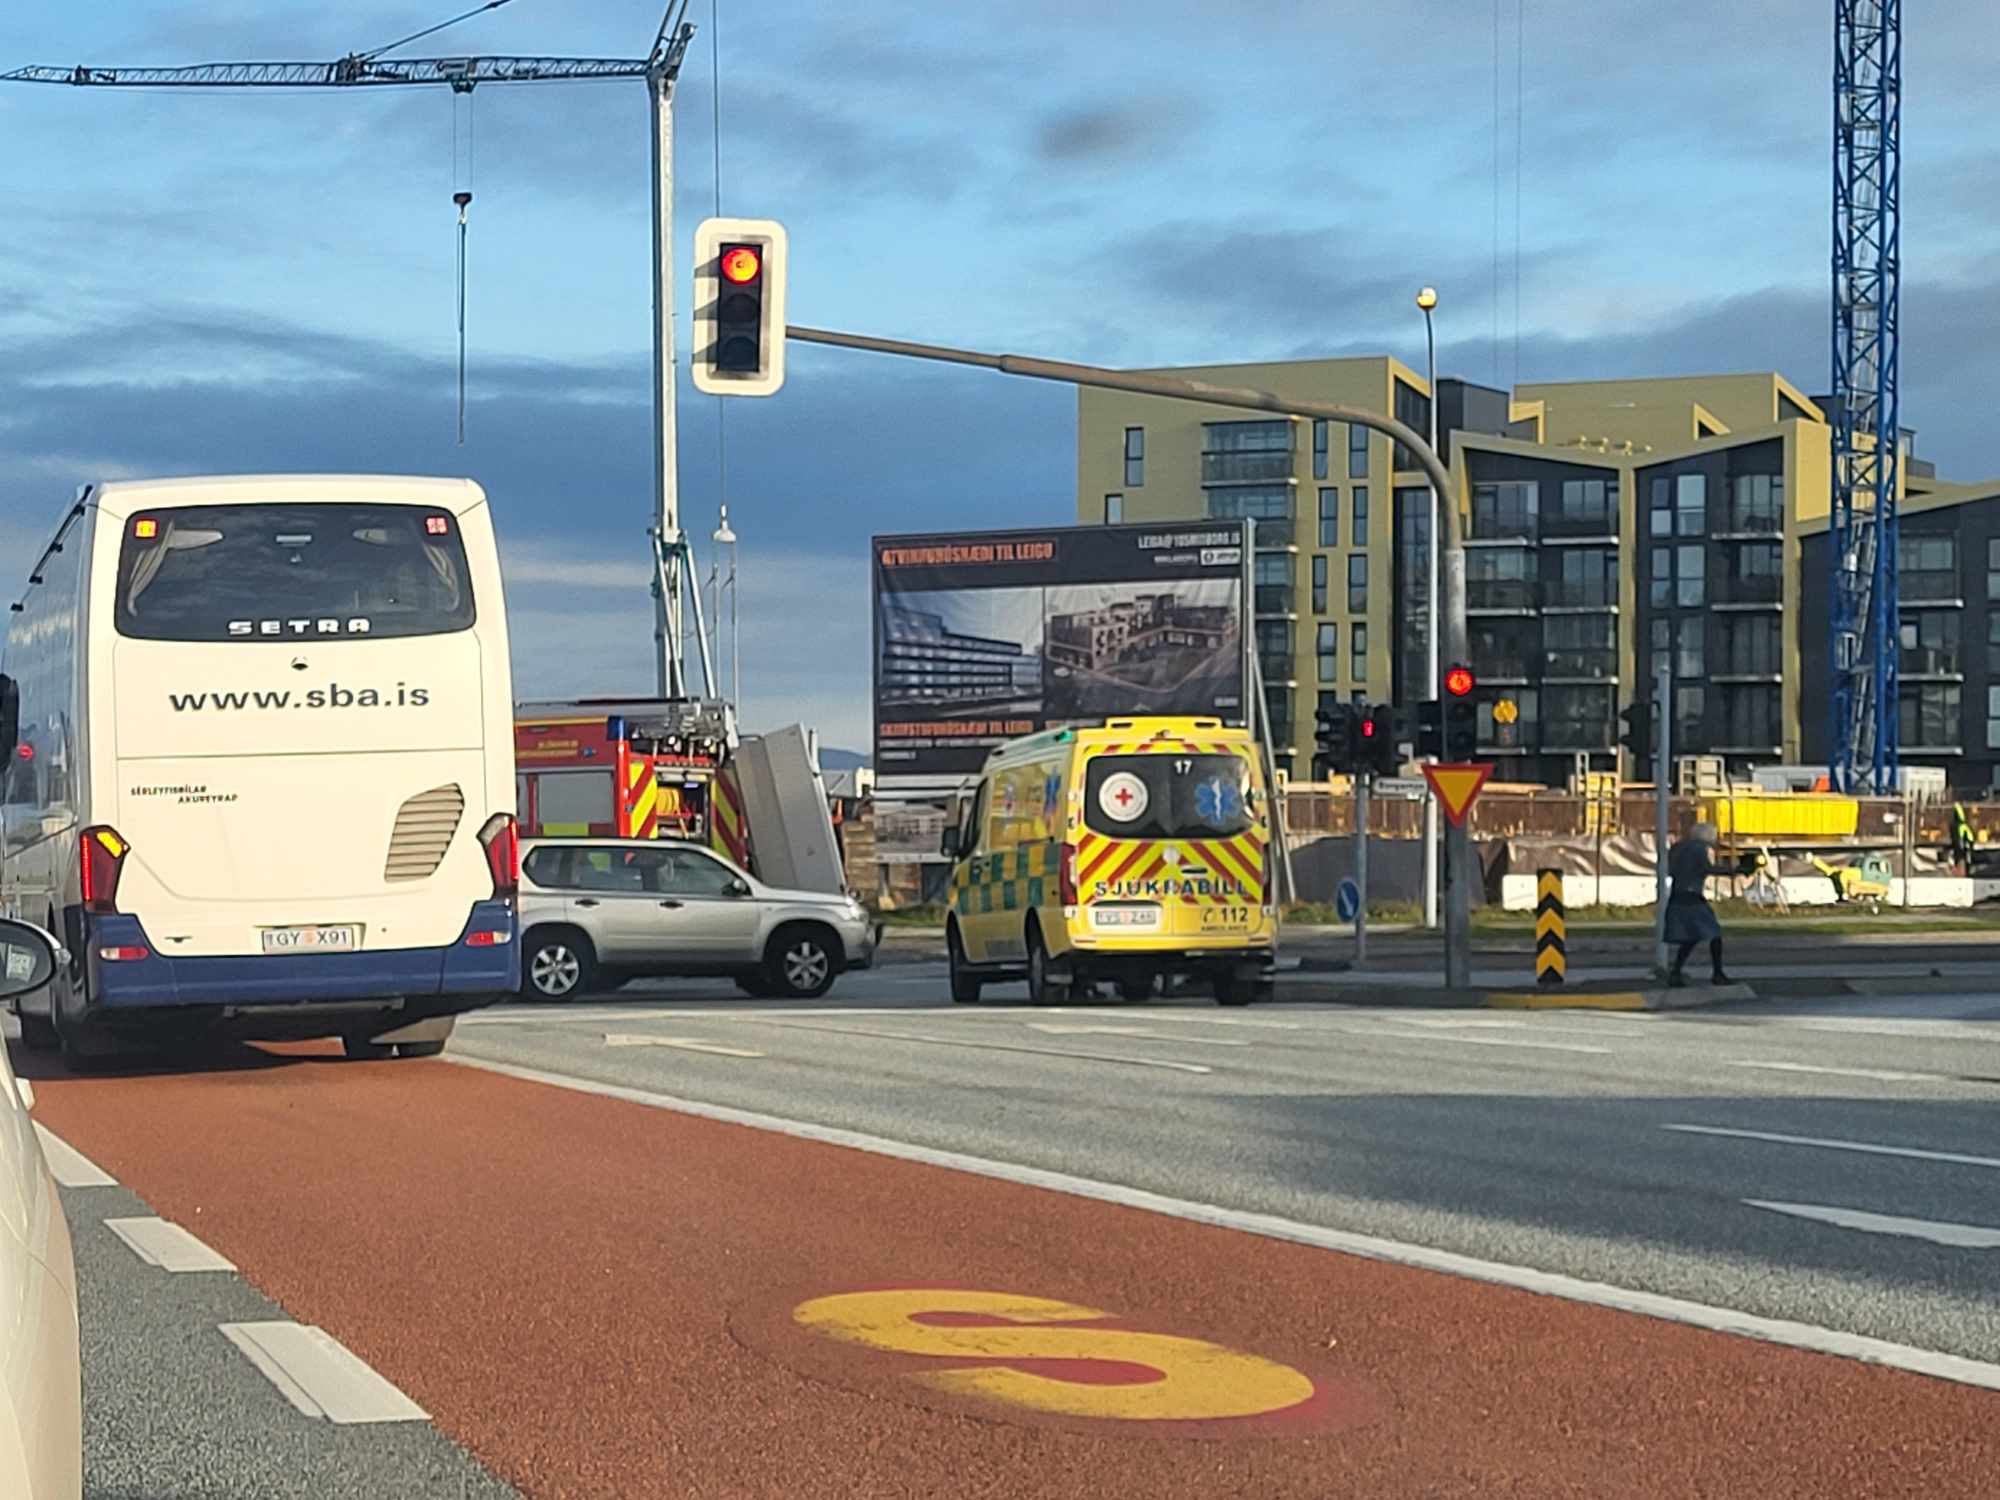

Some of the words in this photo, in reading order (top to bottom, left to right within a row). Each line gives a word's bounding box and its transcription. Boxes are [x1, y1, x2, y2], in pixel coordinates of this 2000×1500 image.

[996, 543, 1014, 560] TIL
[228, 618, 371, 635] SETRA
[169, 682, 429, 711] www.sba.is
[1174, 759, 1193, 775] 17
[1094, 875, 1247, 896] SJÚKRABÍLL
[1220, 906, 1249, 923] 112
[317, 930, 347, 945] X91
[792, 1289, 1315, 1421] S
